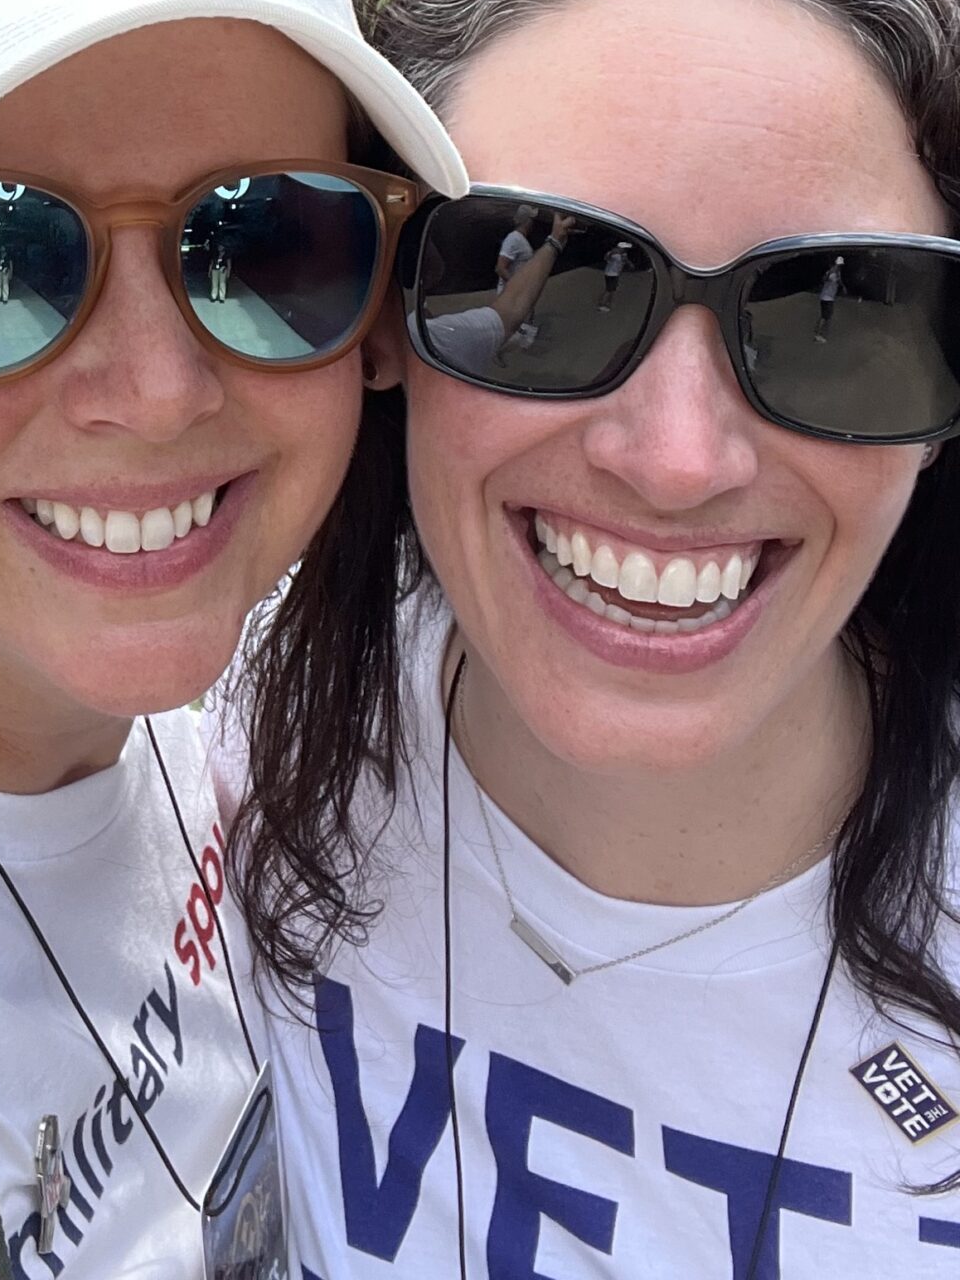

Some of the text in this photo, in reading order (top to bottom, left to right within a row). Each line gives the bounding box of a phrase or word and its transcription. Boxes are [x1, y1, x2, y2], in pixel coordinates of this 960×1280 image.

[862, 1062, 931, 1138] VOTE
[882, 1049, 937, 1105] VET
[314, 974, 852, 1280] VET
[923, 1104, 949, 1123] THE
